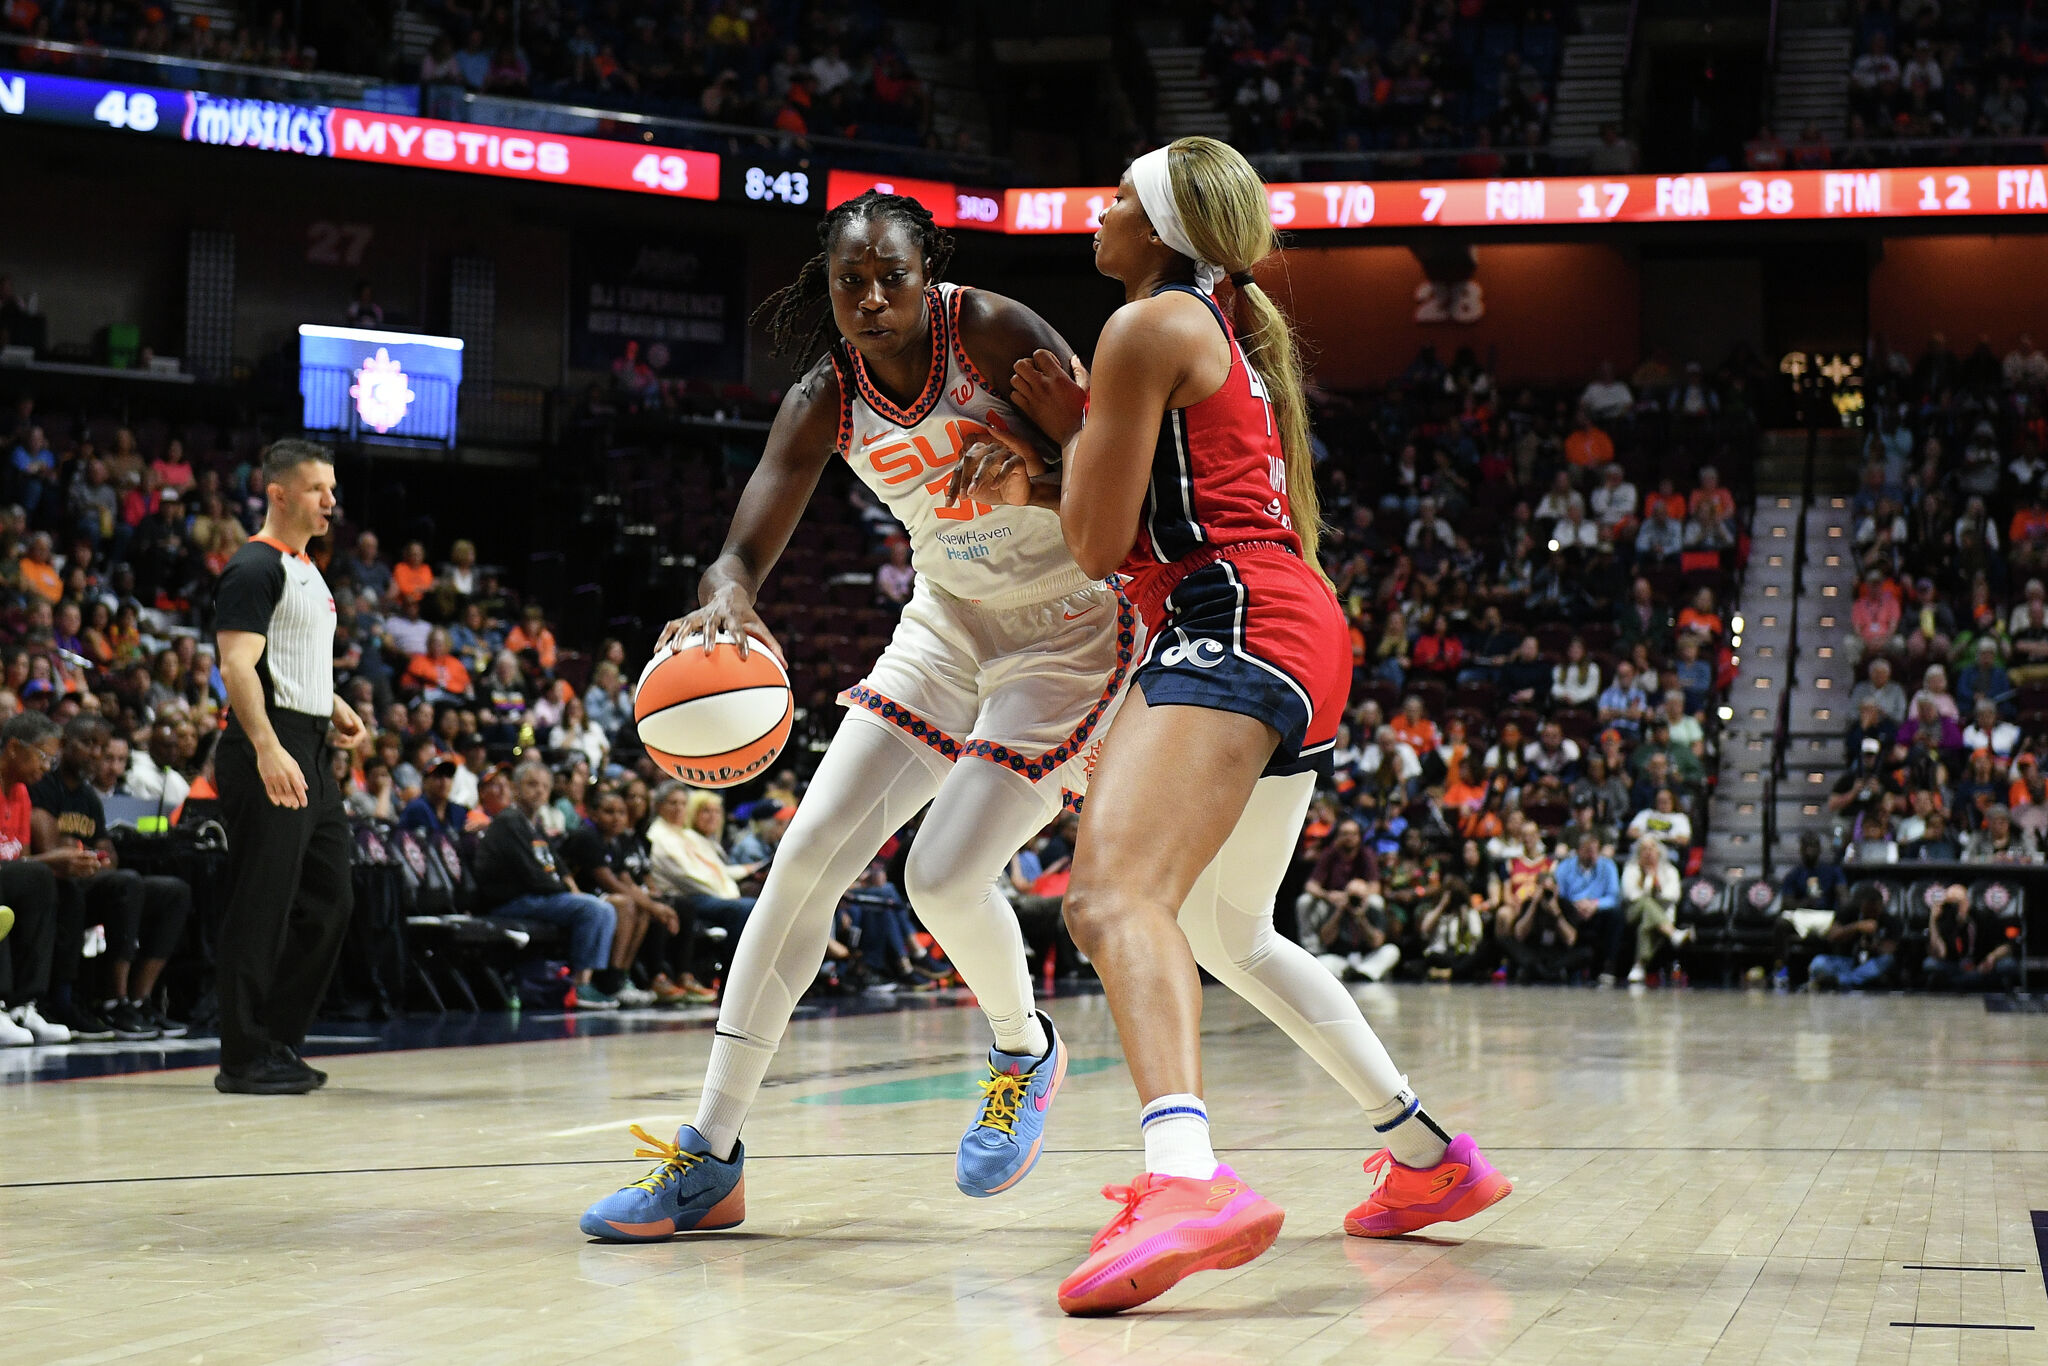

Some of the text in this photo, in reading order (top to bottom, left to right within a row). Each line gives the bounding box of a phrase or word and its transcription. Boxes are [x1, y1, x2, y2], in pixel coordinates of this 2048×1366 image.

[94, 90, 159, 131] 48
[342, 119, 688, 191] MYSTICS 43
[745, 167, 809, 205] 8:43
[1015, 192, 1066, 229] AST
[1269, 191, 1296, 224] 5
[1323, 185, 1375, 228] T/O
[1420, 187, 1447, 221] 7
[1486, 180, 1546, 220] FGM
[1577, 182, 1630, 218] 17
[1656, 177, 1710, 216] FGA
[1738, 179, 1794, 214] 38
[1825, 173, 1881, 213] FTM
[1918, 175, 1971, 211] 12
[1997, 169, 2048, 210] FTA
[306, 220, 374, 265] 27
[1414, 280, 1485, 323] 28
[946, 544, 990, 560] Health
[673, 747, 777, 782] Wilson
